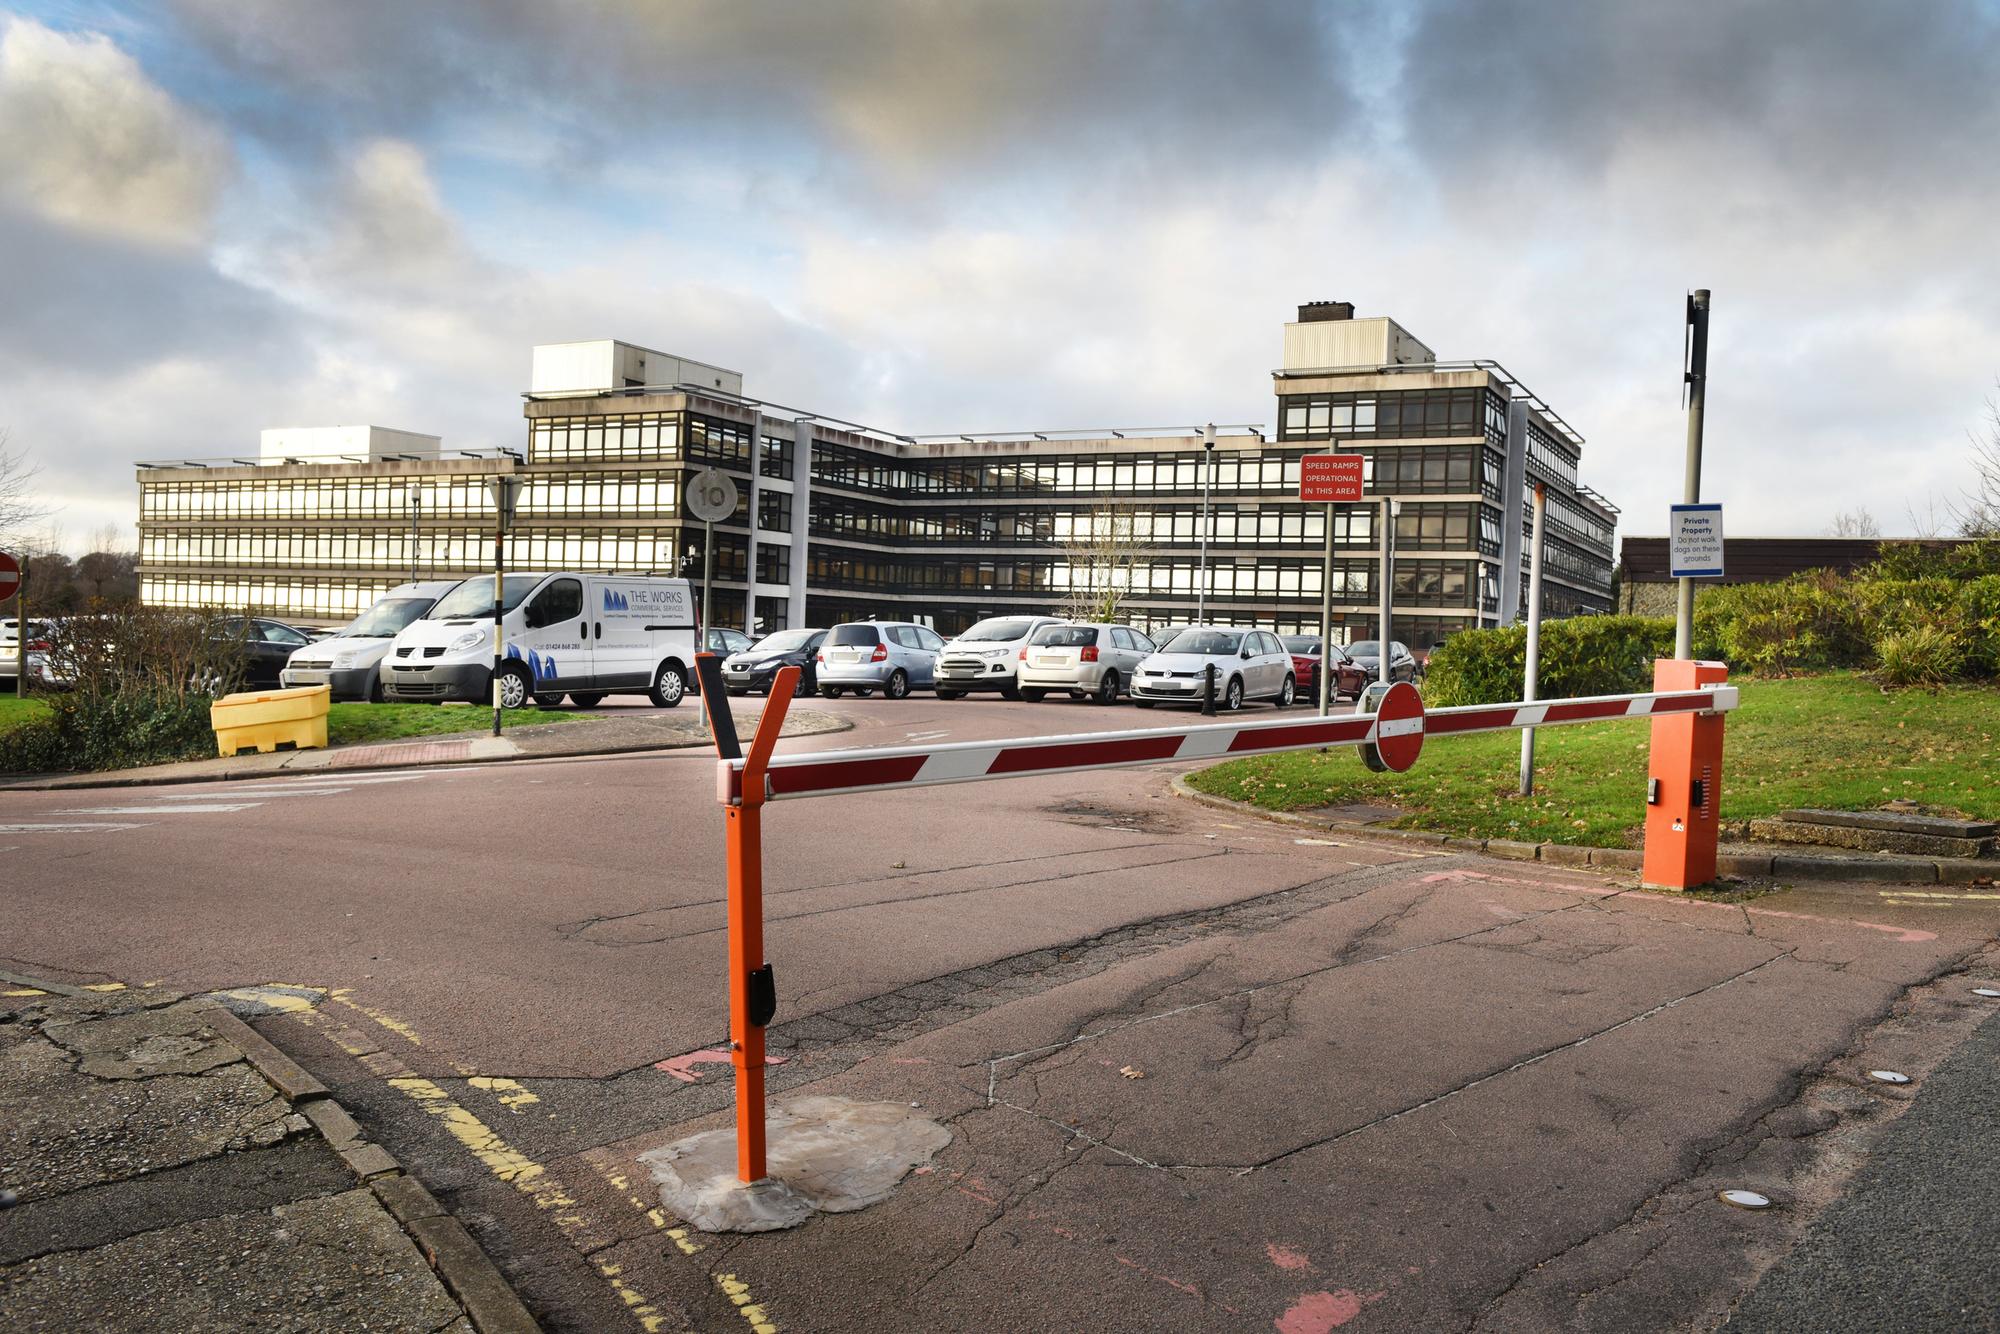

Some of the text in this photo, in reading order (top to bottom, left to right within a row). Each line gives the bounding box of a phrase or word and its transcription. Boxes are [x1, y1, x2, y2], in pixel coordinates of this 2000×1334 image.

[1306, 462, 1359, 470] SPEED RAMPS
[1305, 487, 1356, 495] IN THIS AREA
[699, 486, 725, 507] 10
[1684, 517, 1709, 525] Private
[1681, 527, 1712, 535] Property
[1674, 546, 1691, 554] dogs
[1683, 555, 1711, 563] grounds
[630, 590, 683, 603] THE WORKS
